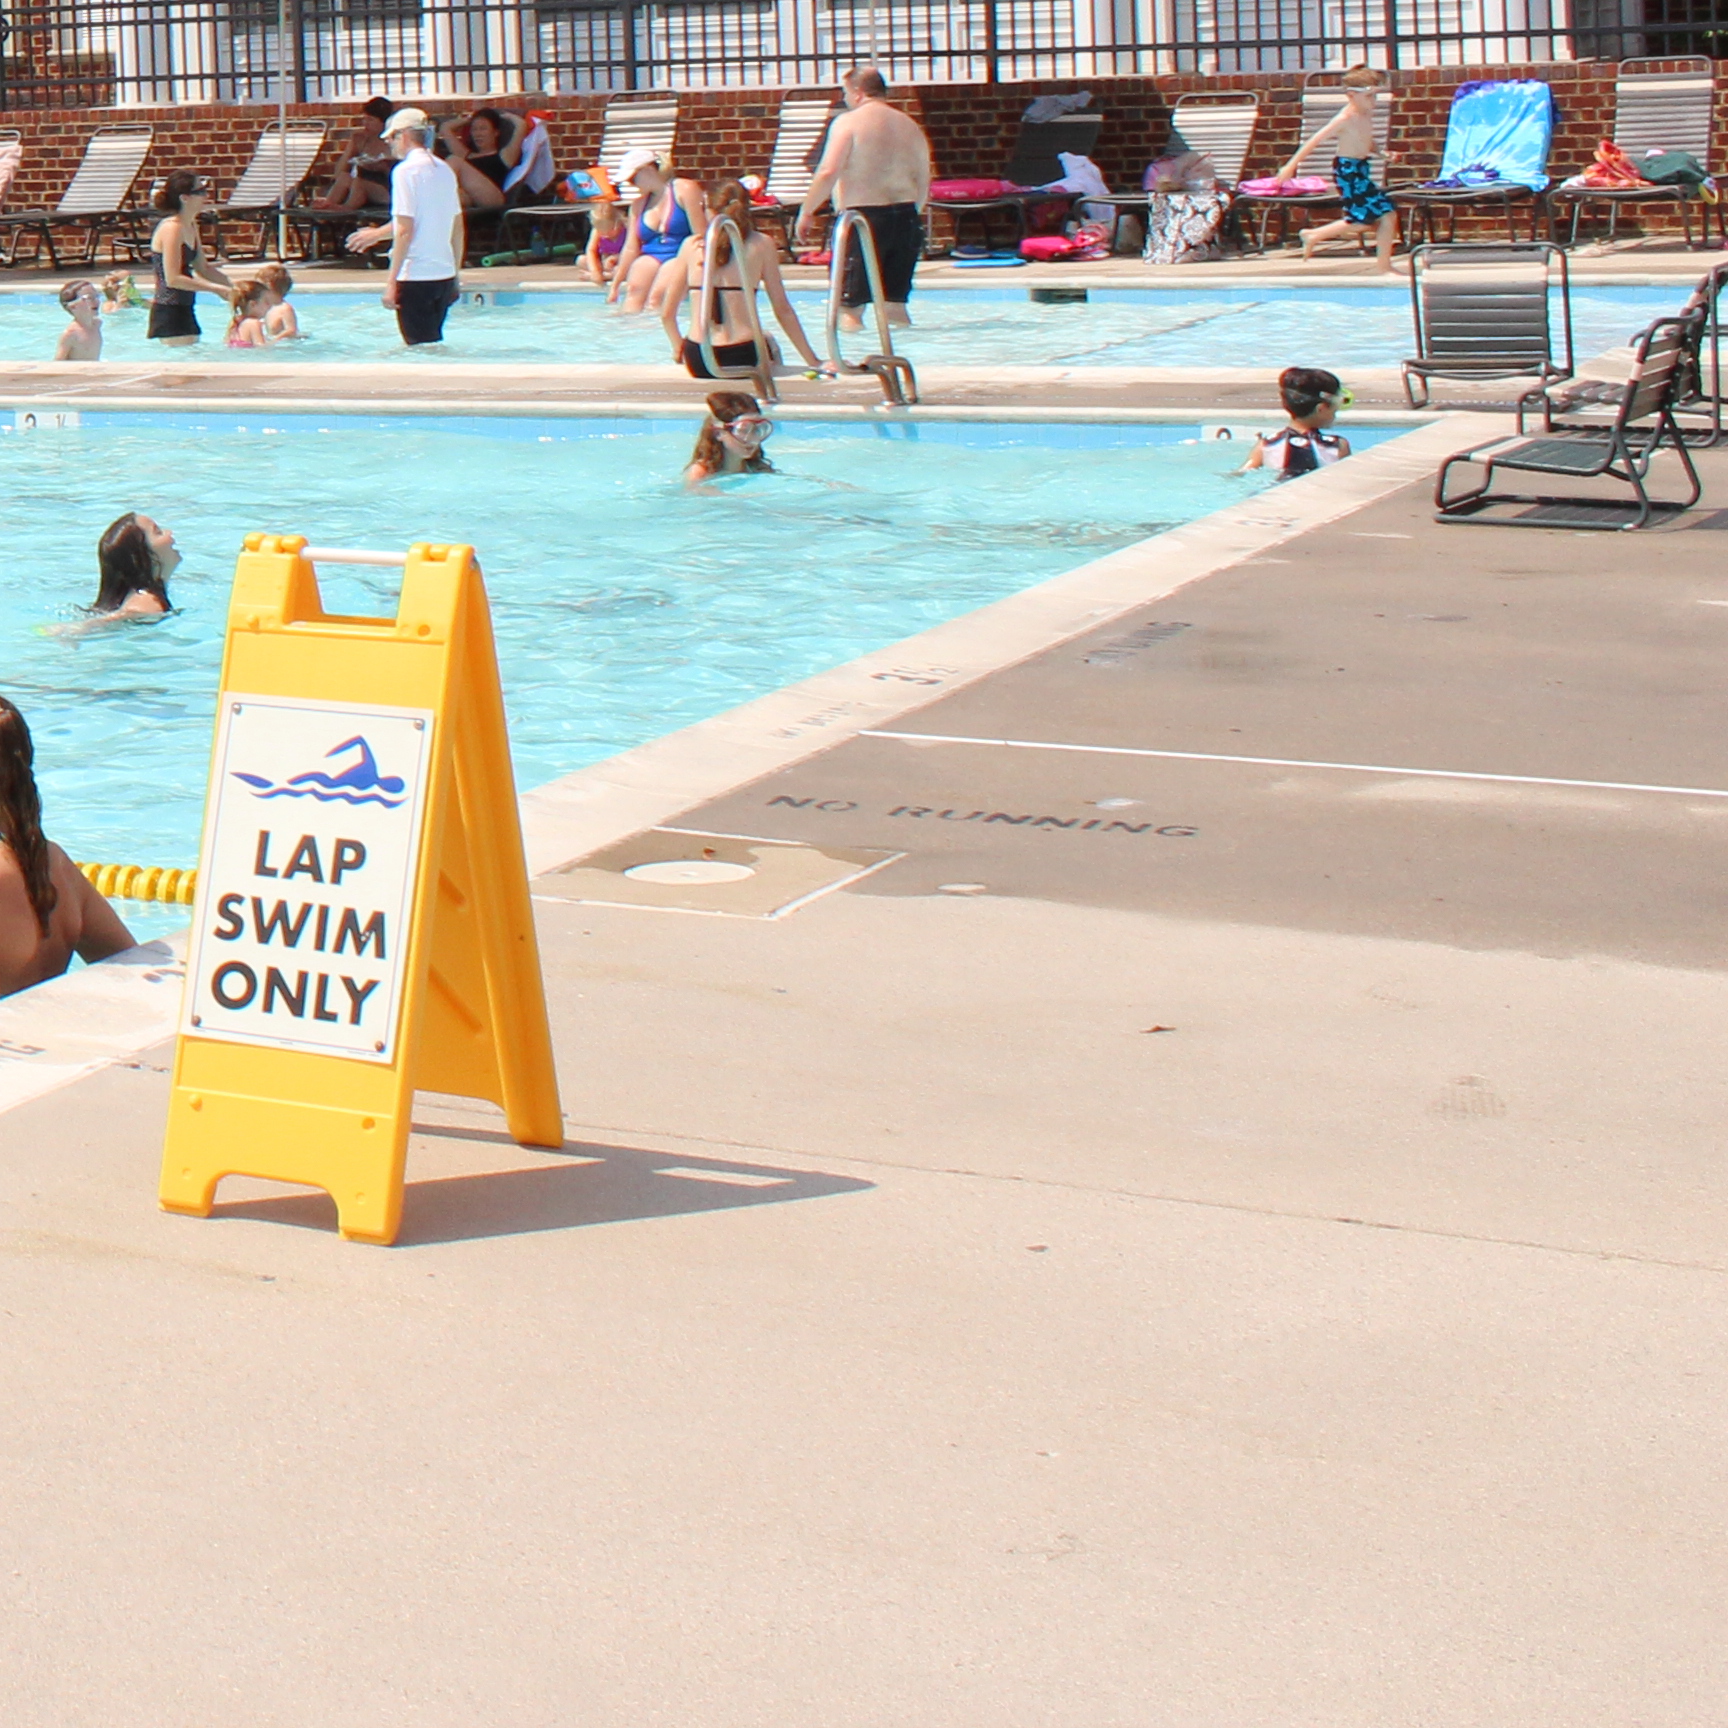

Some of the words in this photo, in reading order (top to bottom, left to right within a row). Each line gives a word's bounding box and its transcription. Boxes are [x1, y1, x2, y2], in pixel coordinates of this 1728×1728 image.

[765, 794, 859, 813] NO
[887, 804, 1202, 839] RUNNING
[254, 829, 367, 885] LAP
[213, 892, 387, 960] SWIM
[211, 959, 382, 1026] ONLY
